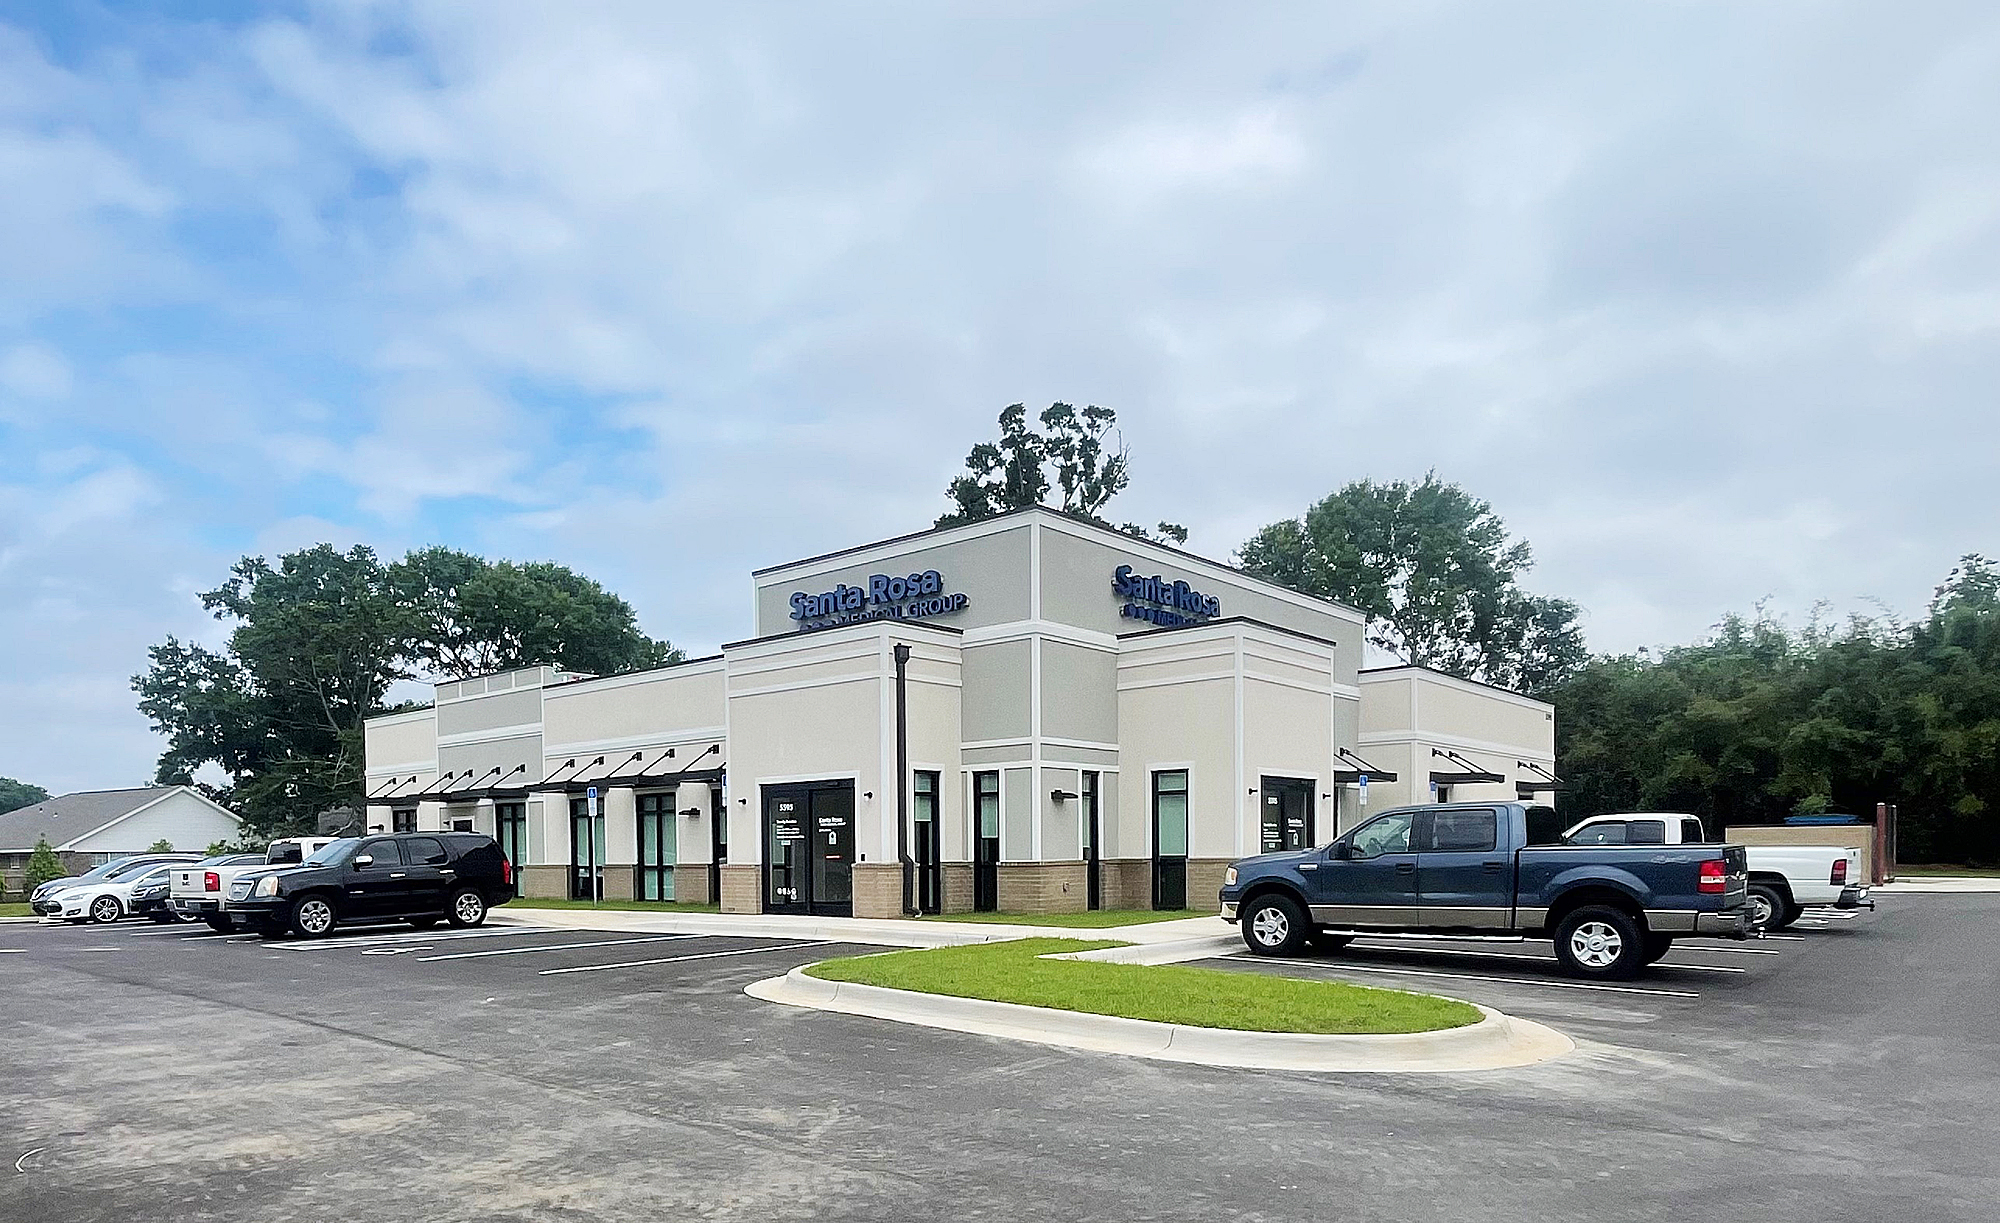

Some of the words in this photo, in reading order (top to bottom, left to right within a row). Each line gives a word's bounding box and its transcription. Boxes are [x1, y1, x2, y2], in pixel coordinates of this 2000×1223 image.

[789, 584, 865, 621] Santa
[869, 570, 943, 604] Rosa
[907, 593, 970, 618] GROUP
[1114, 564, 1173, 607] Santa
[1173, 579, 1221, 618] Rosa
